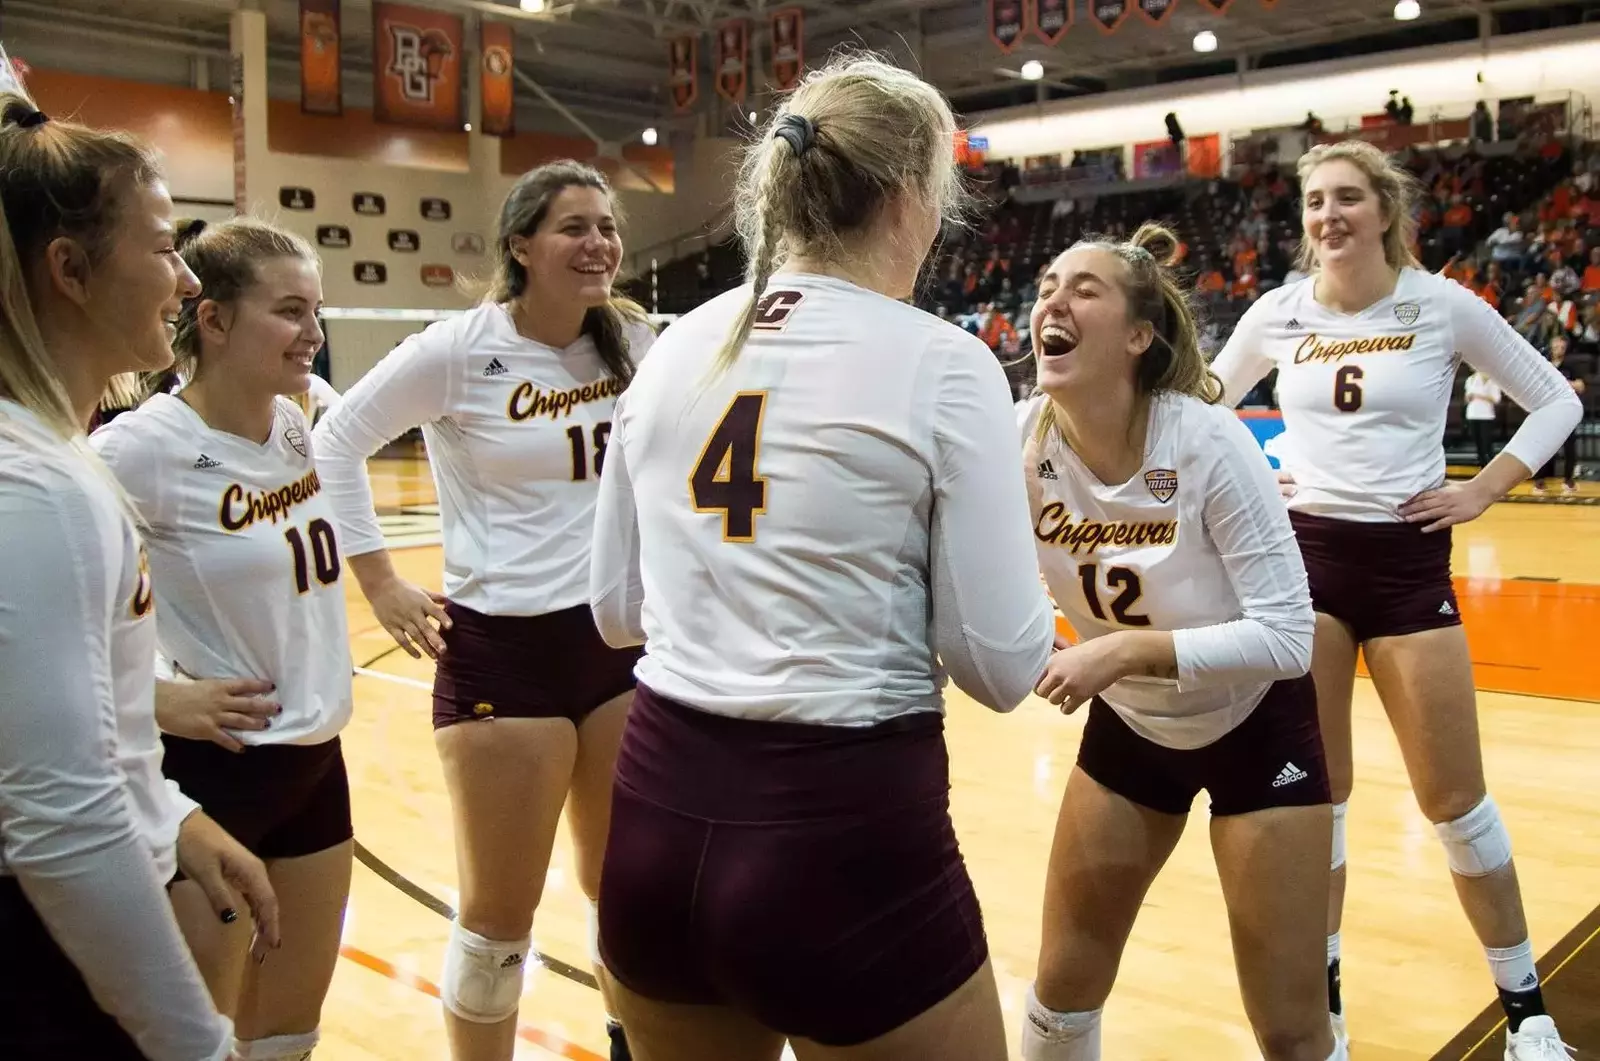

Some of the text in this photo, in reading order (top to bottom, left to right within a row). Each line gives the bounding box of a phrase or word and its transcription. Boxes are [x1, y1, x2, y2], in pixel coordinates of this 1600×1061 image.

[1294, 333, 1416, 364] Chippewas
[508, 378, 618, 421] Chippew
[1334, 365, 1363, 413] 6
[688, 390, 769, 543] 4
[1148, 479, 1177, 489] MAC
[1034, 502, 1178, 554] Chippewas
[284, 517, 340, 595] 10
[1078, 563, 1151, 626] 12
[1272, 770, 1308, 787] adidas
